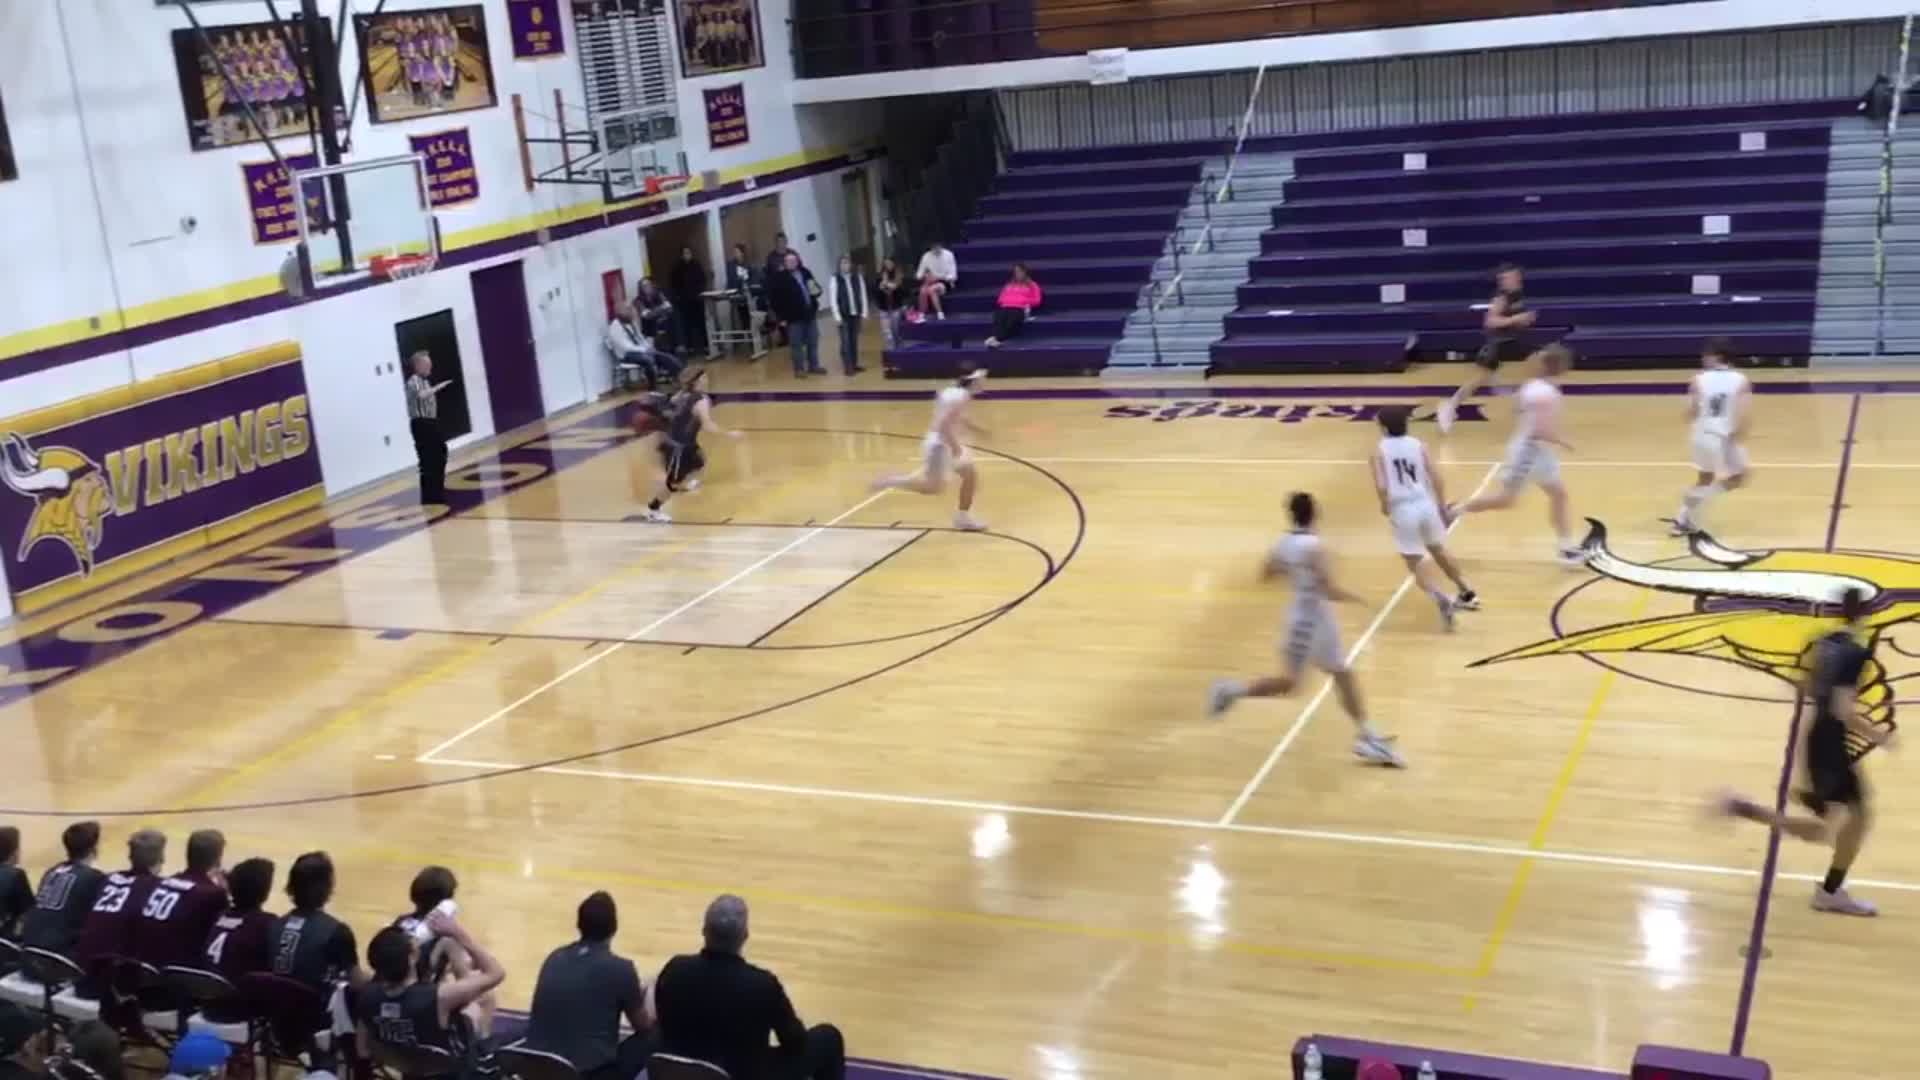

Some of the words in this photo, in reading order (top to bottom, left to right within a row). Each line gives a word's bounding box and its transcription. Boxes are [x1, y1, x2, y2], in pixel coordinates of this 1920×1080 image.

[1102, 401, 1489, 423] Vkings
[104, 394, 310, 517] VIKINGS
[1392, 458, 1417, 485] 14
[92, 884, 131, 912] 23
[141, 888, 180, 921] 50
[207, 931, 227, 965] 4
